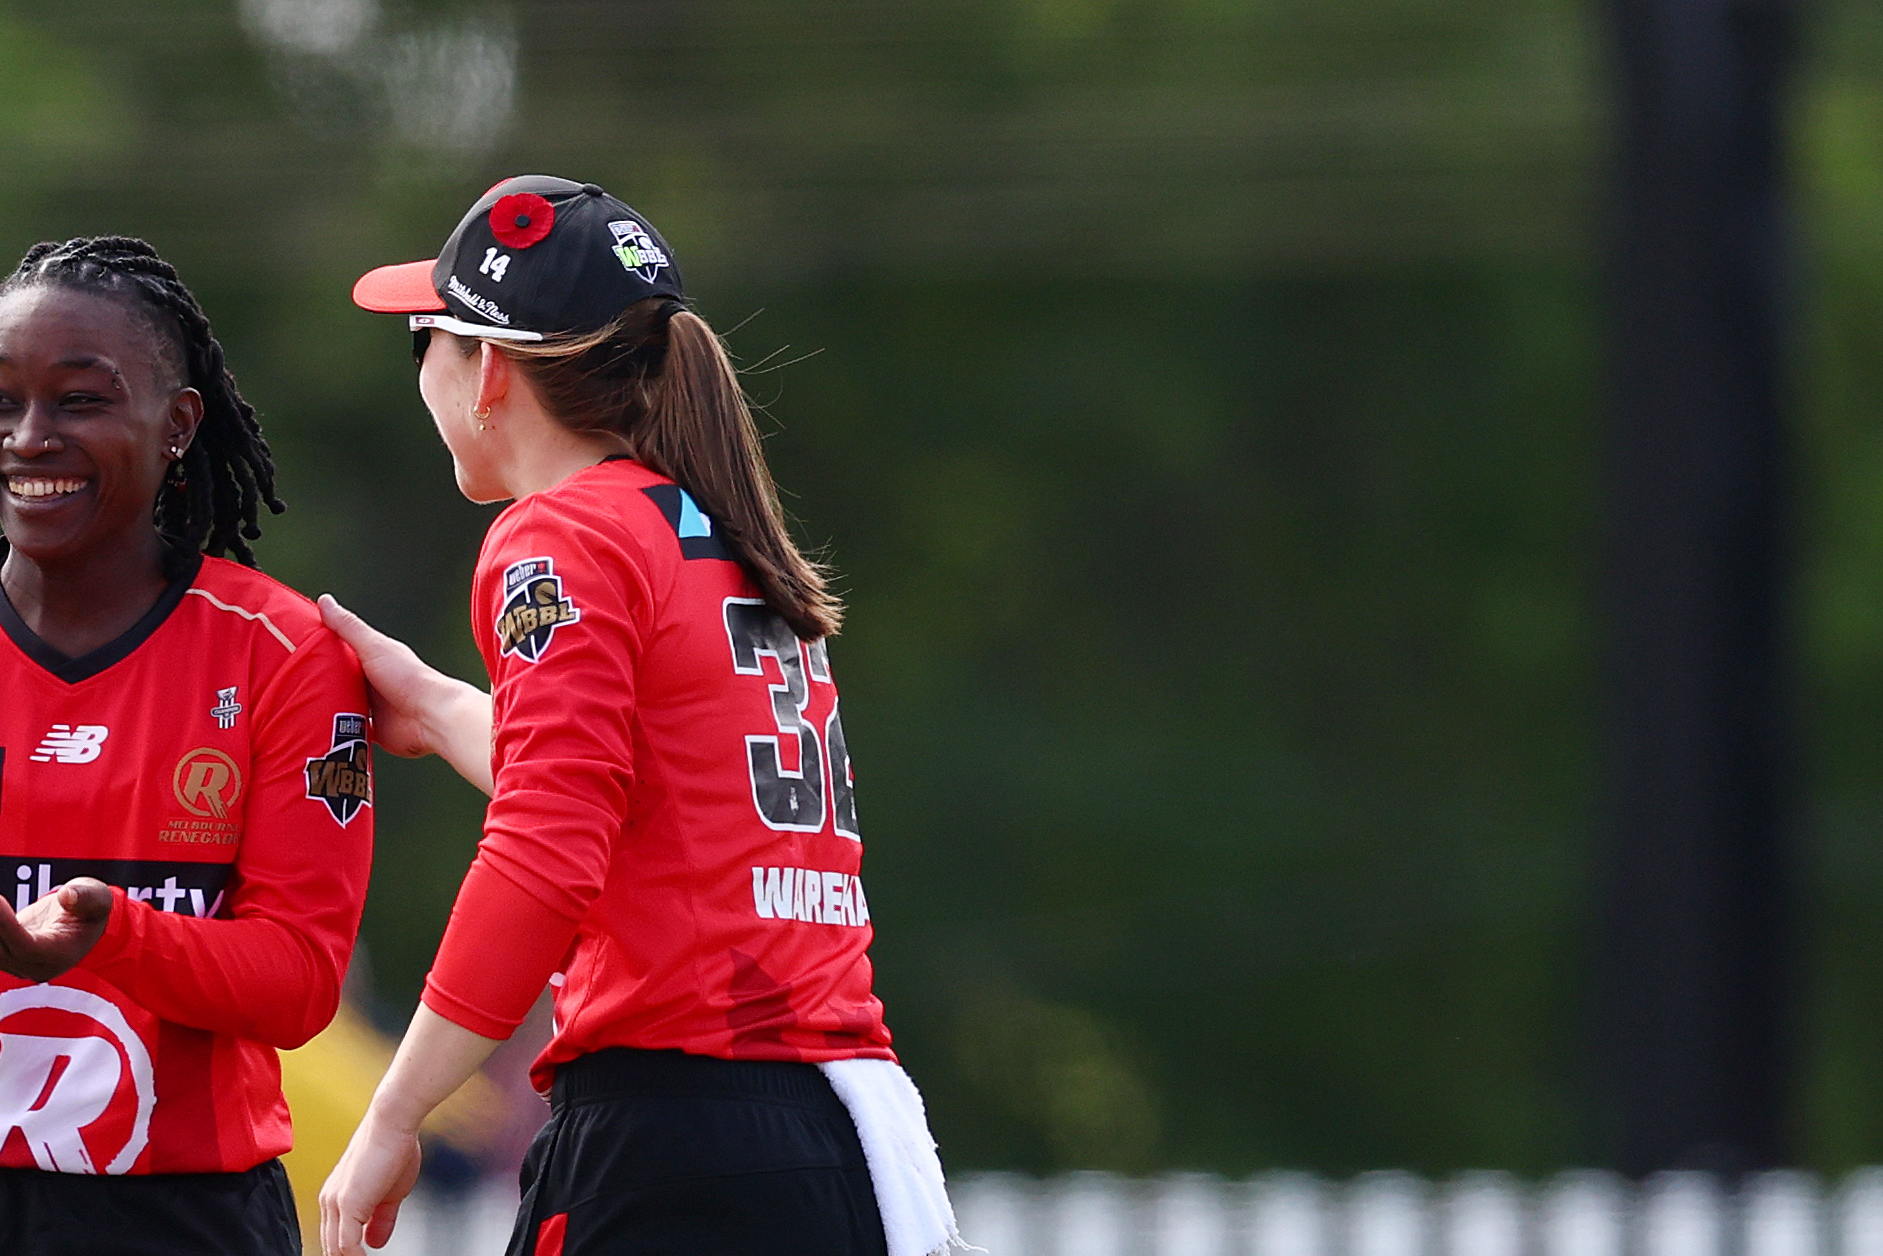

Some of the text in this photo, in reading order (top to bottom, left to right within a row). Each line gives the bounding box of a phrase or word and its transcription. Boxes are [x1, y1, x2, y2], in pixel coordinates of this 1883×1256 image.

[478, 246, 512, 283] 14
[615, 245, 667, 267] WBBL
[508, 563, 537, 586] weber
[497, 602, 576, 654] WBBL
[309, 760, 372, 802] WBB
